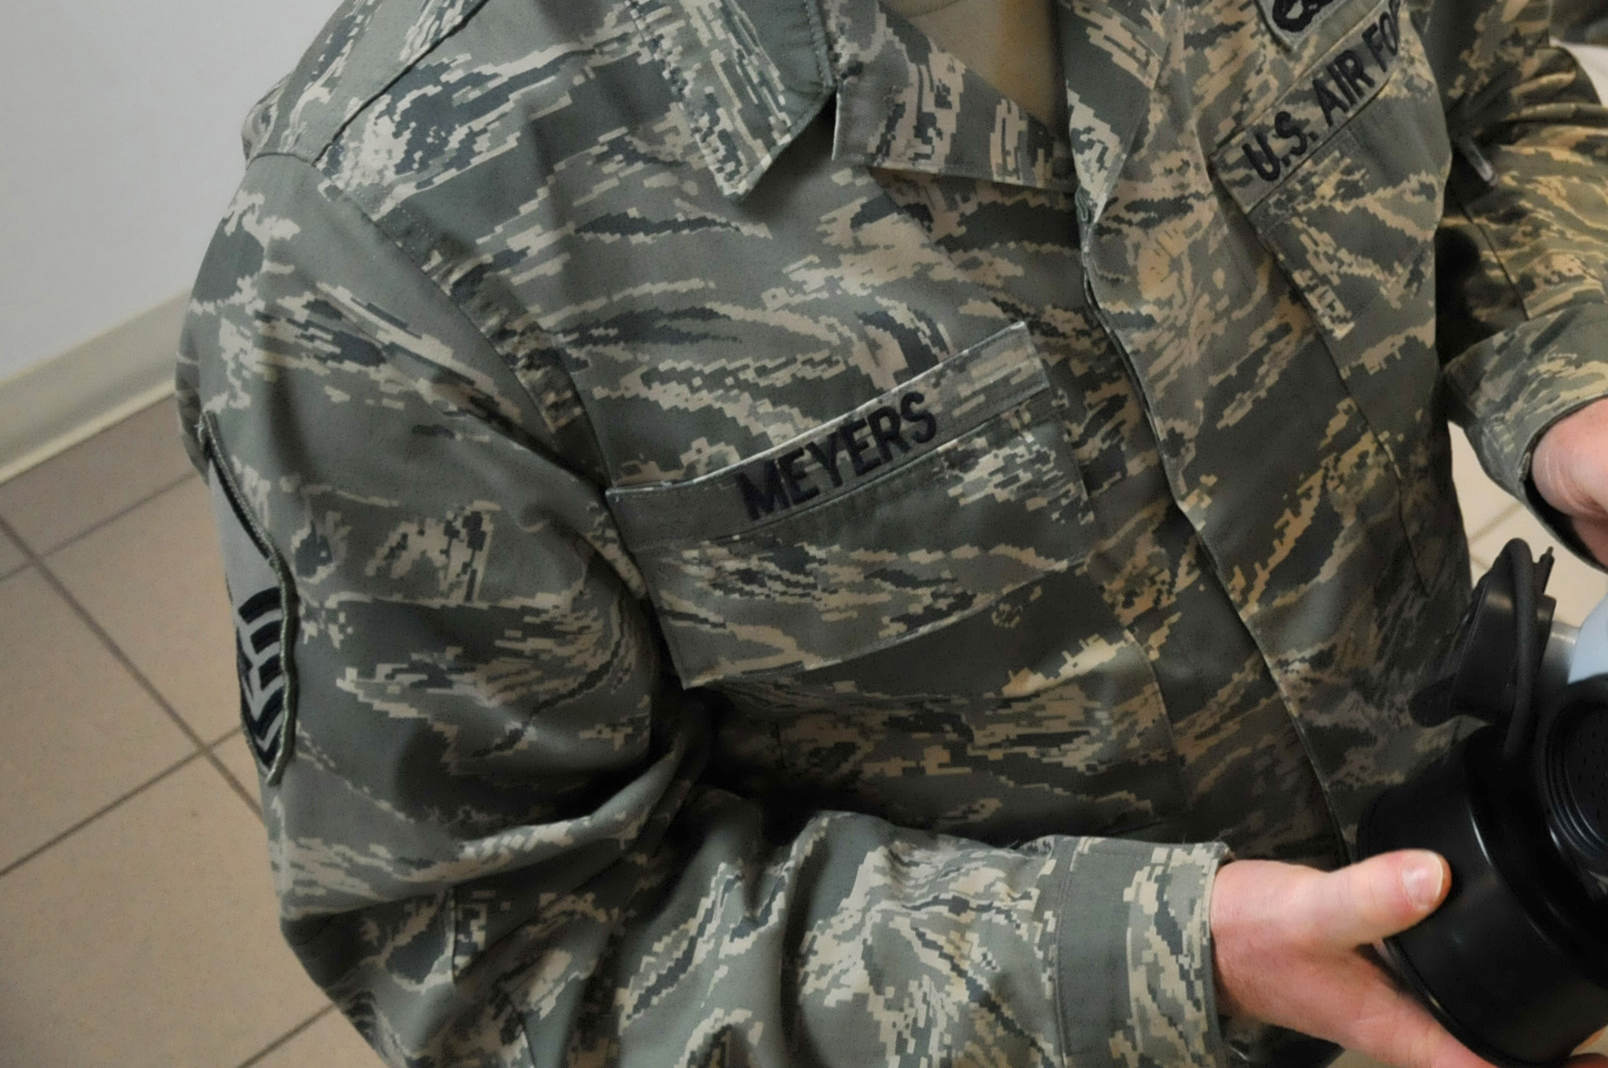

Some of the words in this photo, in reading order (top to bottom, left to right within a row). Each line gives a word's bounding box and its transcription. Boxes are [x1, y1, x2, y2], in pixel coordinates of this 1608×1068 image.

[1242, 111, 1319, 182] U.S.
[1312, 49, 1376, 127] AIR
[735, 391, 937, 520] MEYERS
